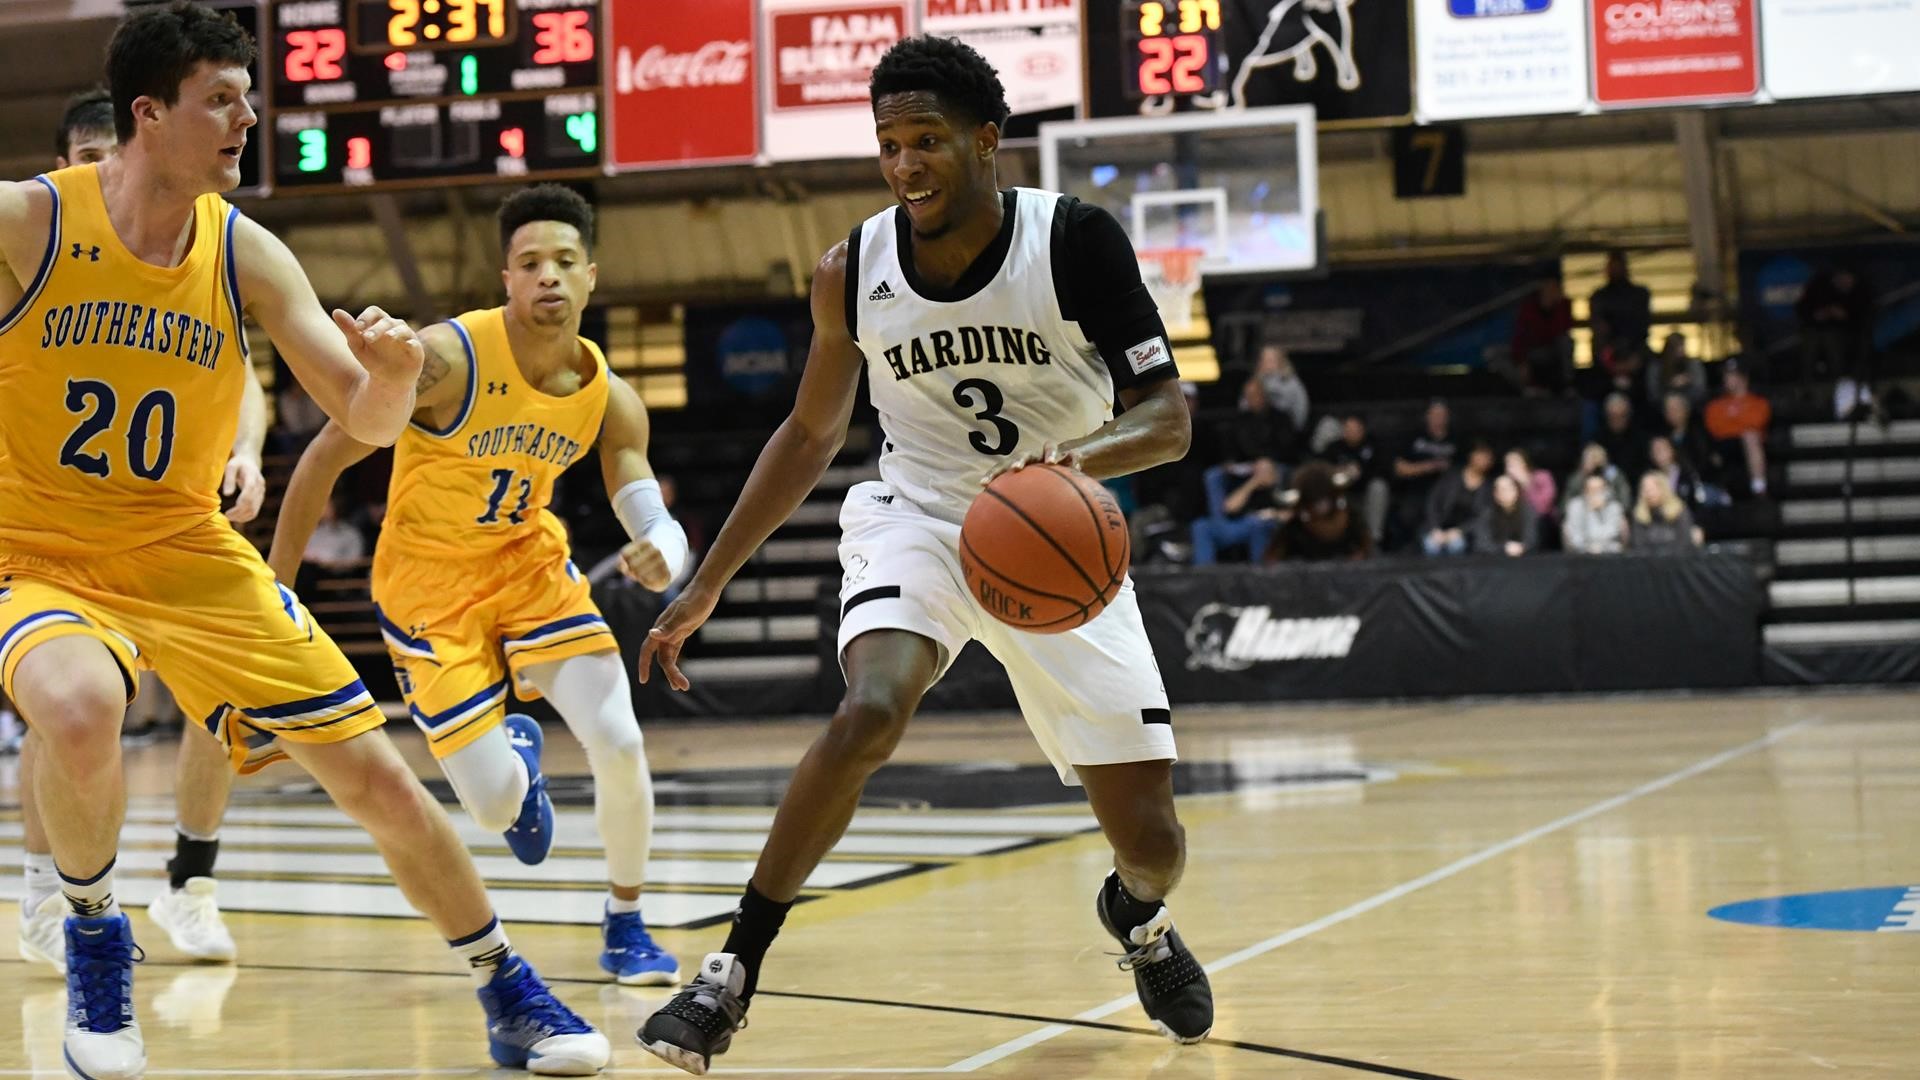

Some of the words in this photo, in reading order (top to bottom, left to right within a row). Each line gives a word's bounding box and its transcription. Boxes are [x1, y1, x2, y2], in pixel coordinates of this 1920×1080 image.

[388, 0, 504, 46] 2:37
[532, 10, 594, 64] 36
[811, 14, 898, 43] FARM
[285, 28, 346, 82] 22
[461, 54, 478, 95] 1
[634, 40, 749, 92] Coca-Cola
[780, 42, 889, 76] BUREA
[1138, 34, 1208, 94] 22
[298, 128, 327, 171] 3
[566, 111, 596, 152] 4
[1411, 131, 1446, 191] 7
[869, 292, 896, 301] adidas
[41, 301, 225, 371] SOUTHEASTERN
[883, 325, 1051, 381] HARDING
[60, 378, 176, 481] 20
[953, 378, 1019, 456] 3
[980, 579, 1034, 620] ROCK
